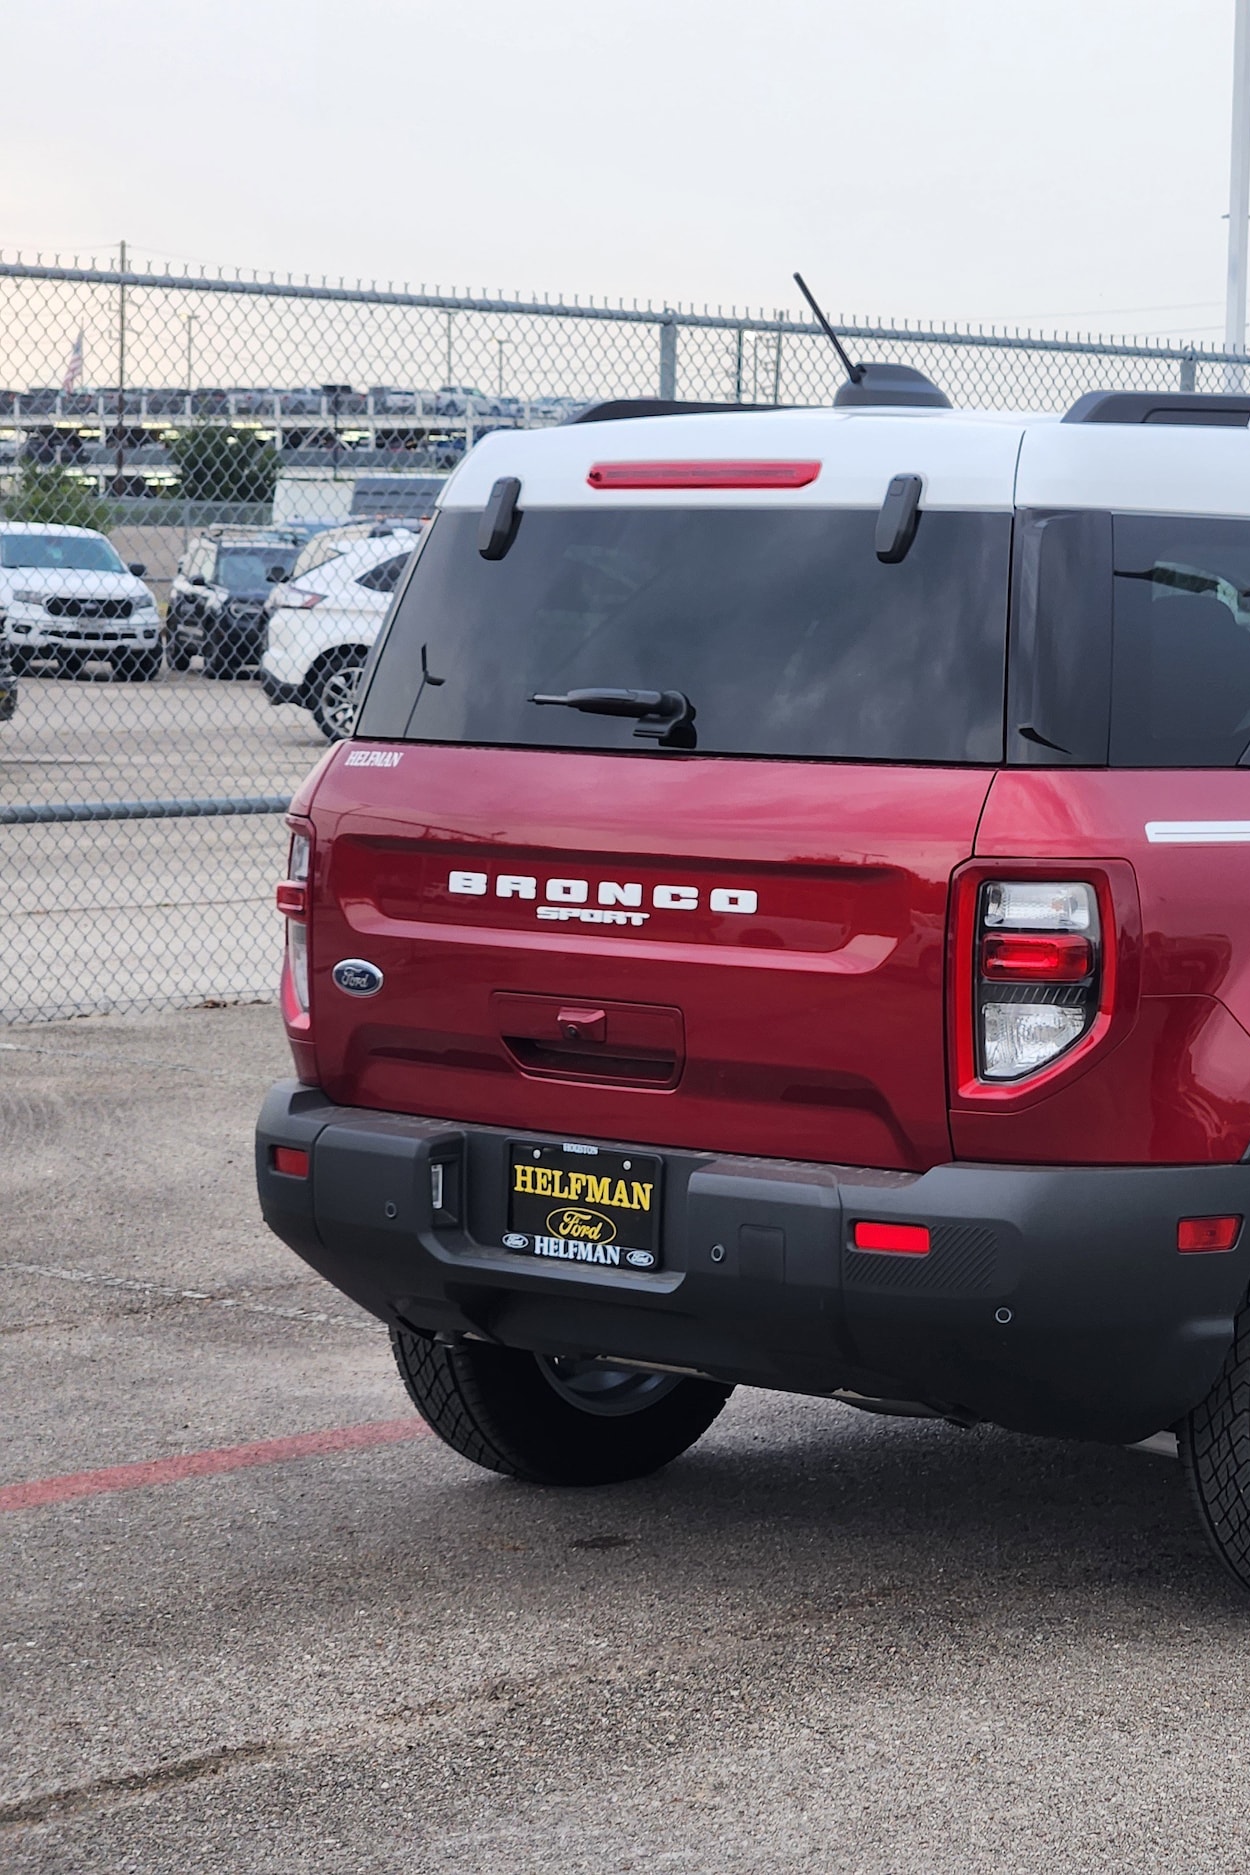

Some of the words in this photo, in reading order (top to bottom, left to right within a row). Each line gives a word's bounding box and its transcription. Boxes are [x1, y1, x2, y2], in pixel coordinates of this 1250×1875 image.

[448, 870, 758, 914] BRONCO
[536, 906, 650, 926] SPORT
[341, 966, 369, 988] Ford
[513, 1164, 654, 1211] HELFMAN
[558, 1210, 603, 1240] Ford
[533, 1235, 621, 1266] HELFMAN
